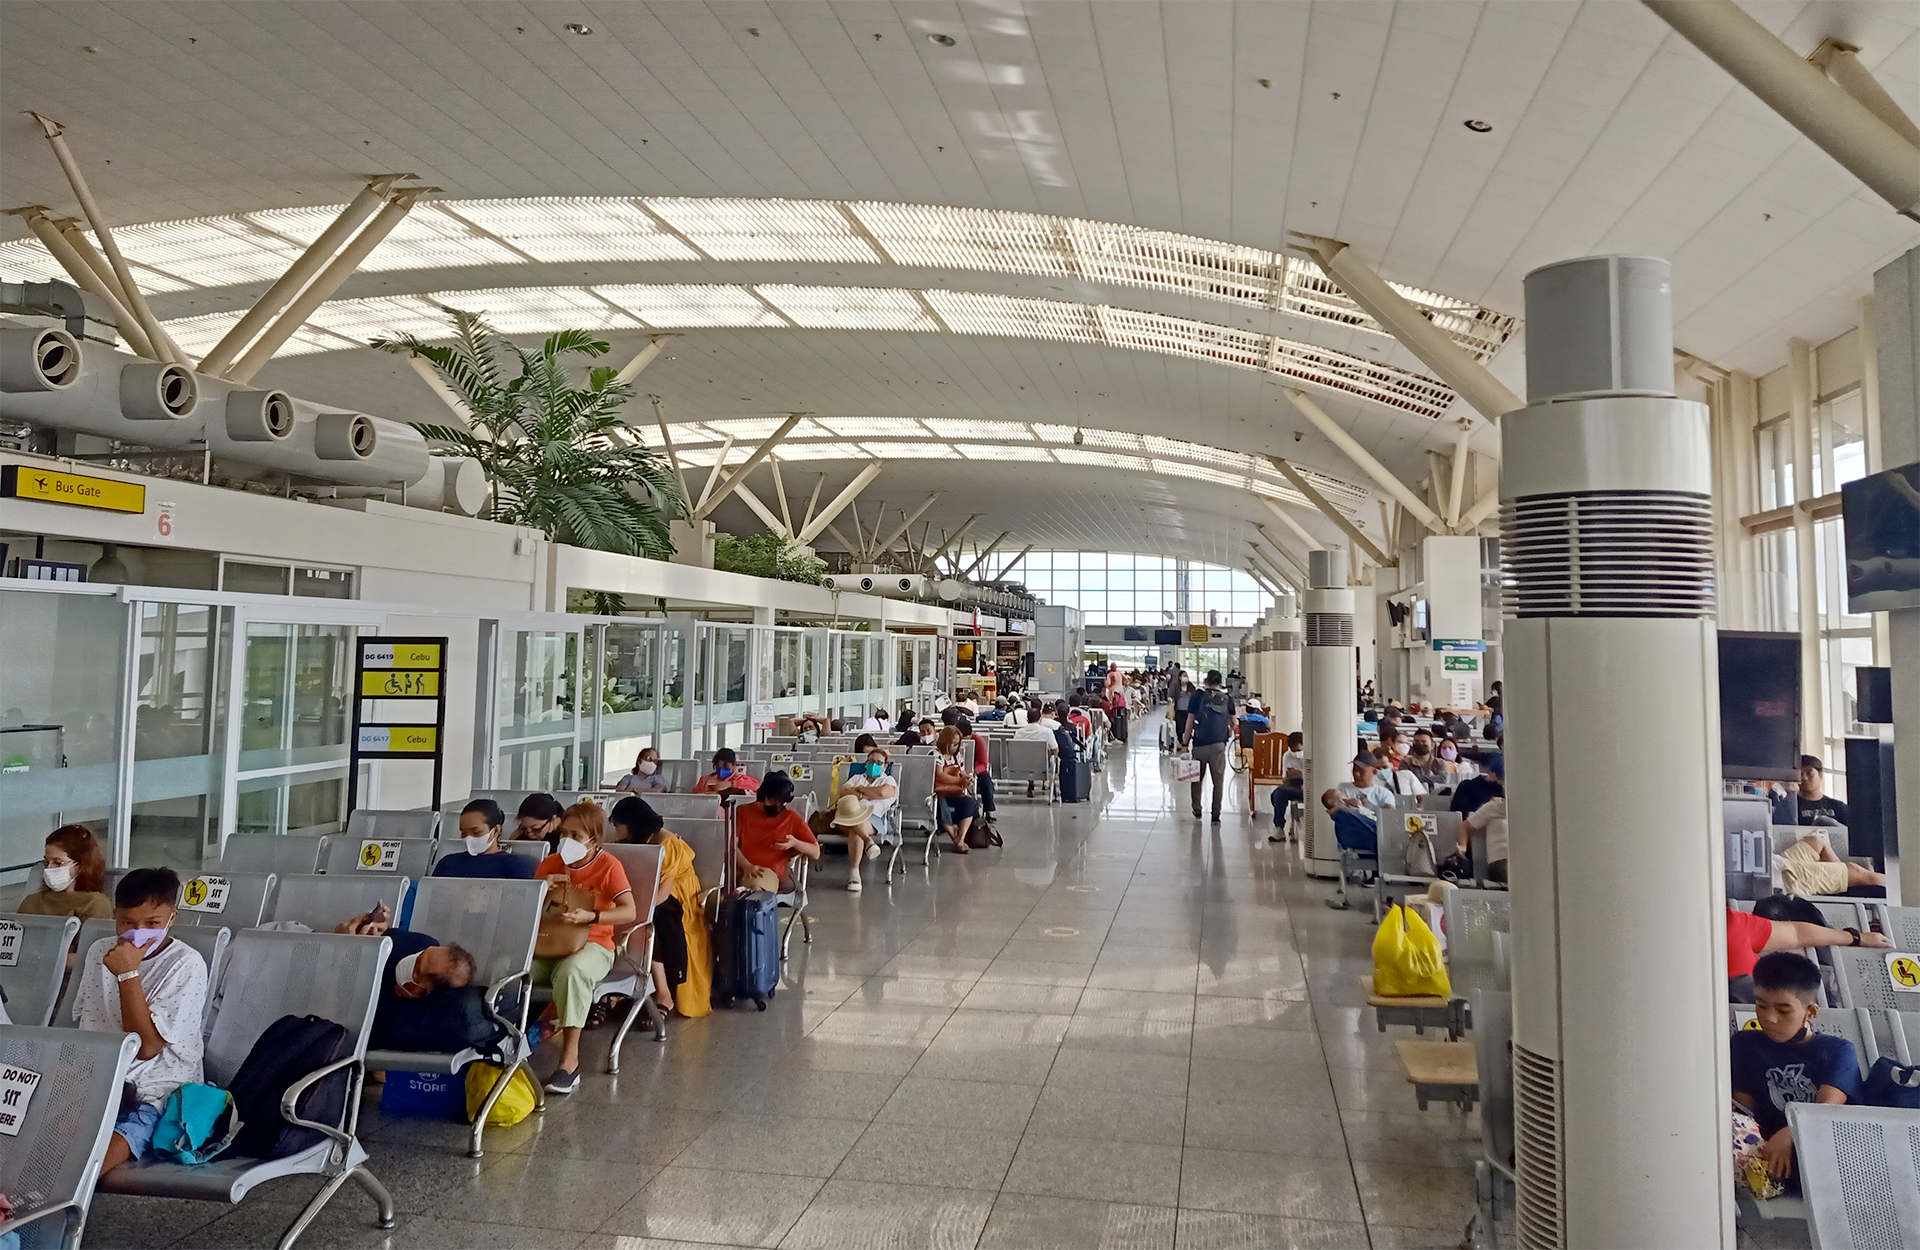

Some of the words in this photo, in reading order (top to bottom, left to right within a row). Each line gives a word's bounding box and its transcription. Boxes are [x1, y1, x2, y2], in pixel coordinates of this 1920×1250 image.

[55, 480, 74, 493] Bus
[77, 484, 101, 498] Gate
[158, 513, 171, 536] 6
[410, 652, 431, 661] Cebu
[406, 735, 427, 744] Cebu
[385, 851, 395, 859] SIT
[211, 888, 223, 899] SIT
[206, 901, 221, 909] HERE
[2, 935, 16, 947] SIT
[2, 1068, 18, 1081] DO
[17, 1071, 38, 1086] NOT
[409, 1079, 448, 1093] STORE
[2, 1088, 22, 1107] SIT
[0, 1112, 17, 1127] ERE
